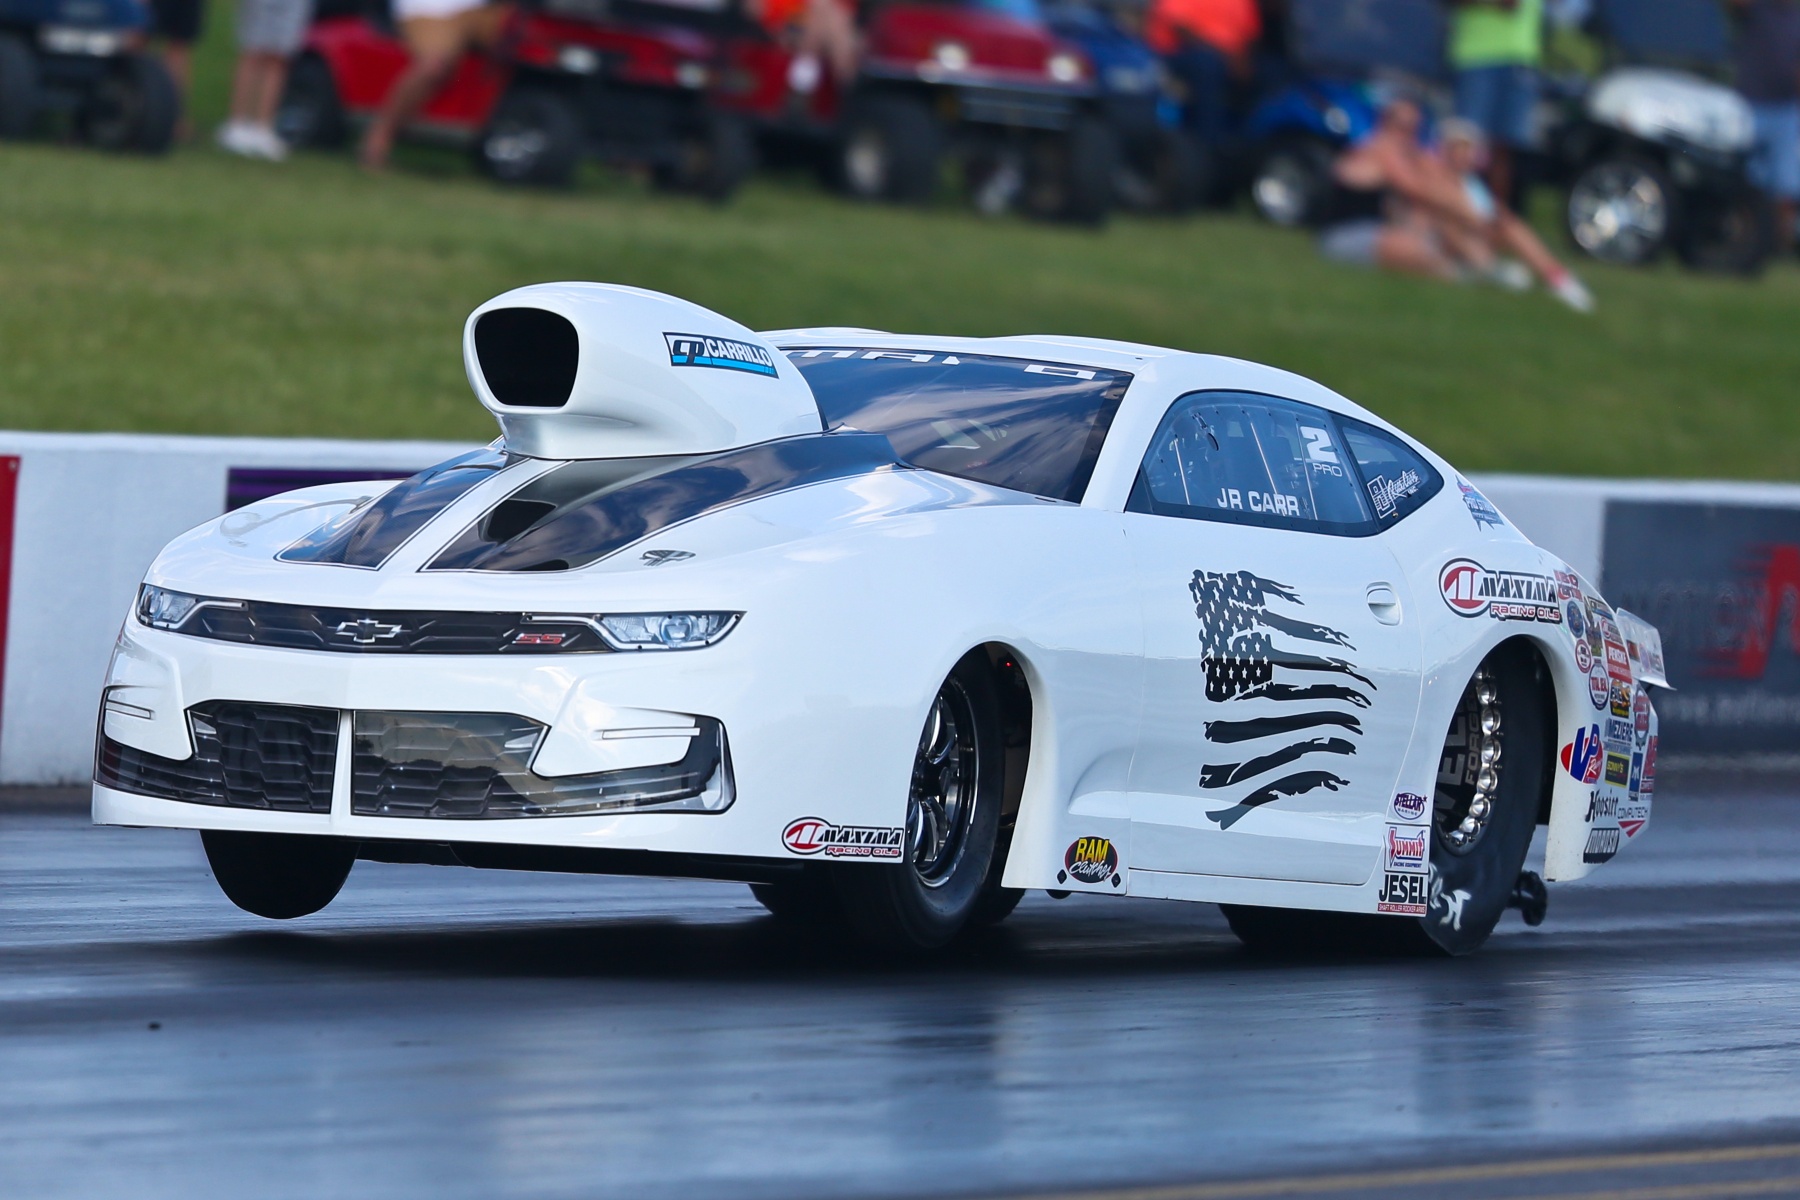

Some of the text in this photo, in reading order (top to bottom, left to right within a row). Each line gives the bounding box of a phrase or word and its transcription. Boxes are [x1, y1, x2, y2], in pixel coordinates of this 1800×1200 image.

[705, 338, 773, 367] CARRILLO
[1300, 426, 1339, 463] 2
[1313, 463, 1343, 477] PRO
[1217, 488, 1300, 516] JR CARR
[1478, 577, 1557, 603] MAXIMA
[1538, 608, 1560, 620] OILS
[512, 633, 566, 645] SS
[1570, 723, 1600, 782] VP
[1394, 793, 1422, 811] STELLAR
[817, 829, 901, 845] MAXIMA
[872, 848, 900, 856] OILS
[1075, 838, 1109, 863] RAM
[1379, 874, 1427, 904] JESEL
